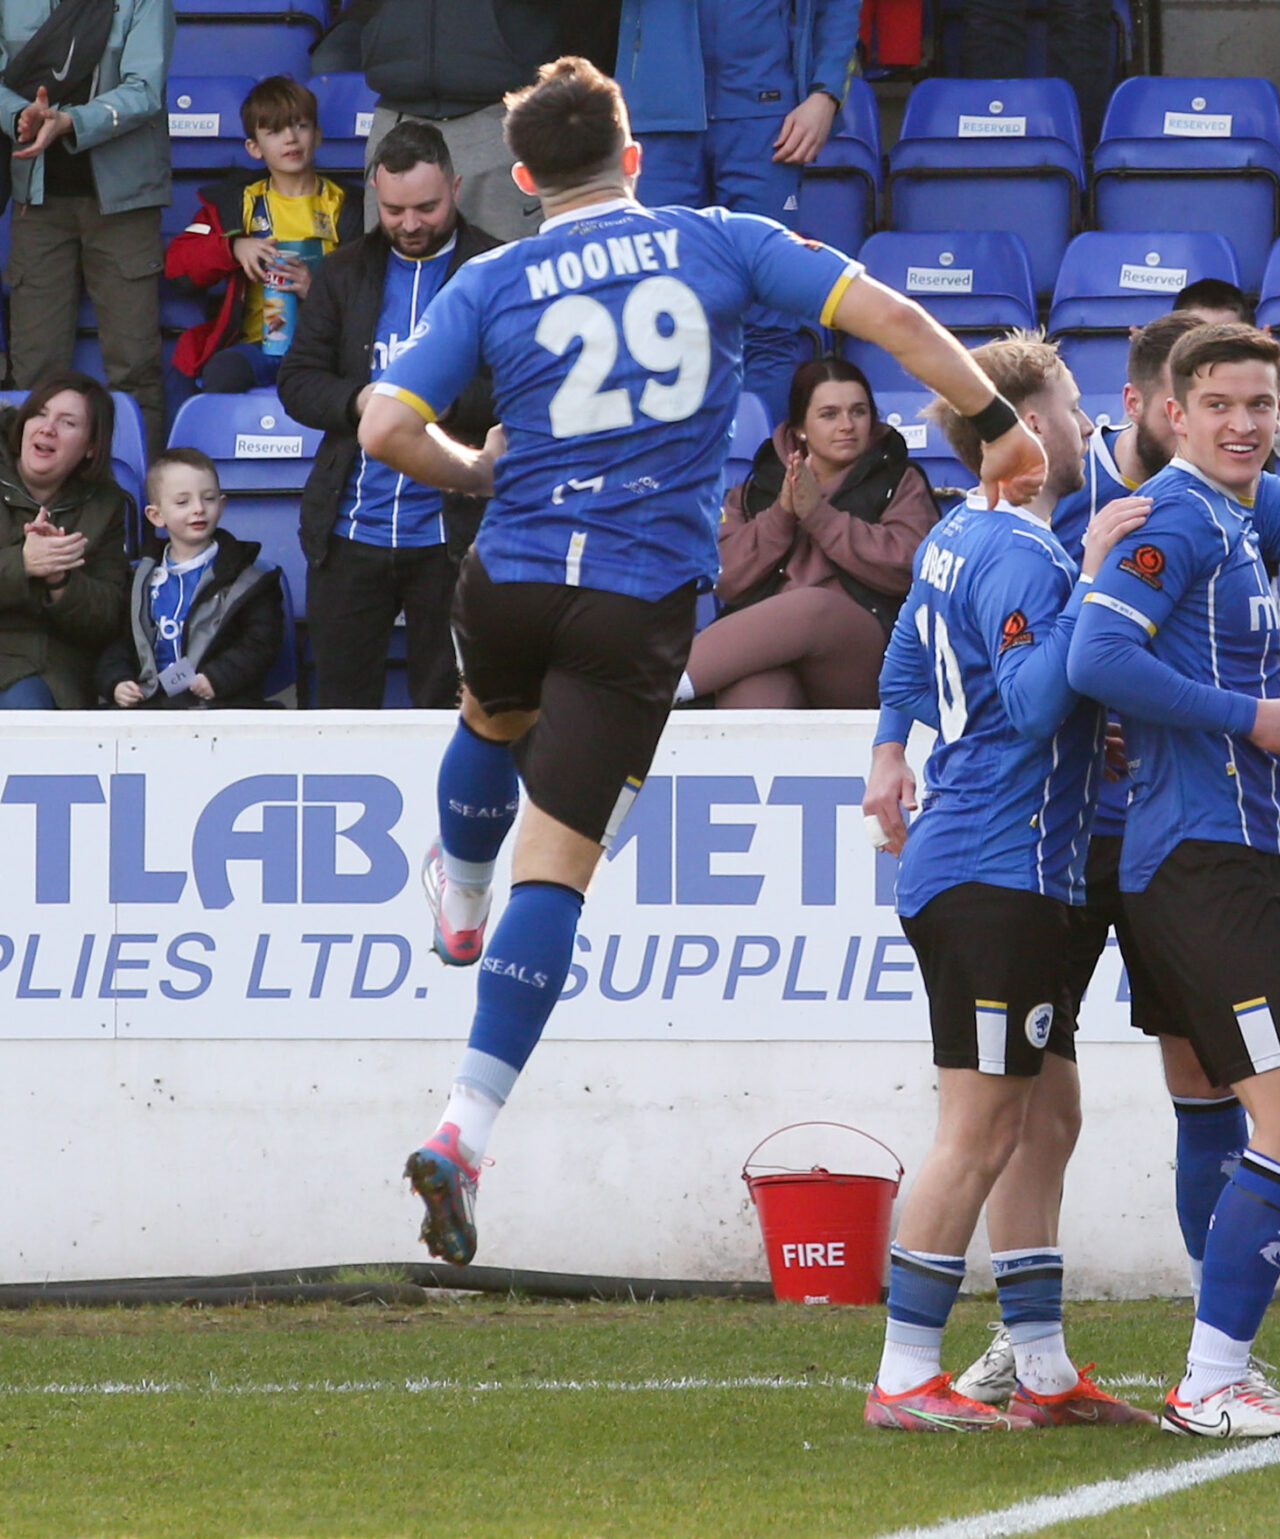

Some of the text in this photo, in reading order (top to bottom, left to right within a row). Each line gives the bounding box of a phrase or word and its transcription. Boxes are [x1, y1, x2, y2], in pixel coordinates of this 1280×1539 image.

[171, 119, 215, 130] SERVED
[963, 121, 1021, 133] RESERVED
[1168, 117, 1227, 132] RESERVED
[524, 228, 680, 300] MOONEY
[908, 271, 971, 287] Reserved
[1122, 270, 1184, 287] Reserved
[534, 275, 711, 438] 29
[238, 440, 300, 454] Reserved
[449, 799, 519, 818] SEALS
[0, 773, 409, 909] TLAB
[246, 933, 428, 999] LTD.
[555, 934, 915, 1001] SUPPLIE
[481, 956, 549, 988] SEALS
[782, 1242, 846, 1268] FIRE
